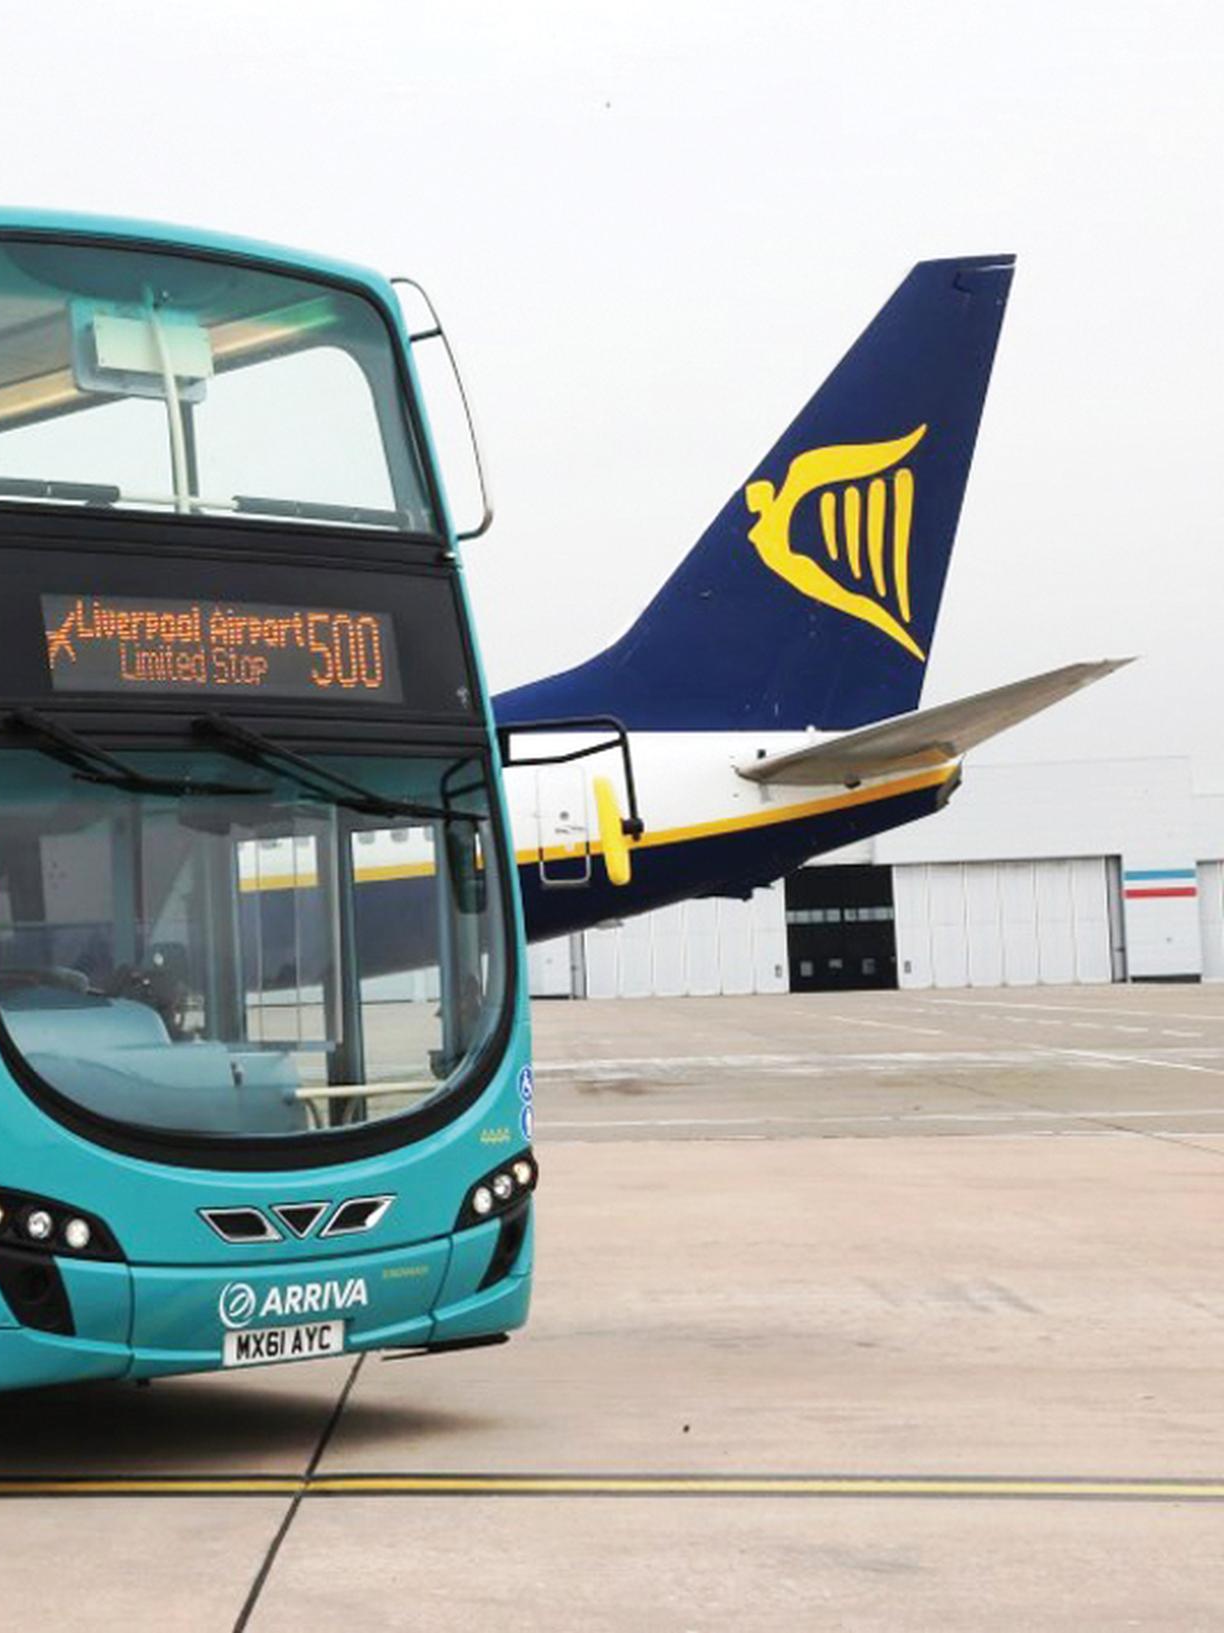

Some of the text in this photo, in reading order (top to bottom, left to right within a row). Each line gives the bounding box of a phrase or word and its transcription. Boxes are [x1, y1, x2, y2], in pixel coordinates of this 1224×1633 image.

[76, 599, 305, 647] Liverpool Airport
[120, 643, 269, 686] Limited Stop
[307, 612, 382, 688] 500
[259, 1277, 368, 1317] ARRIVA
[236, 1325, 332, 1360] MX61 AYC
